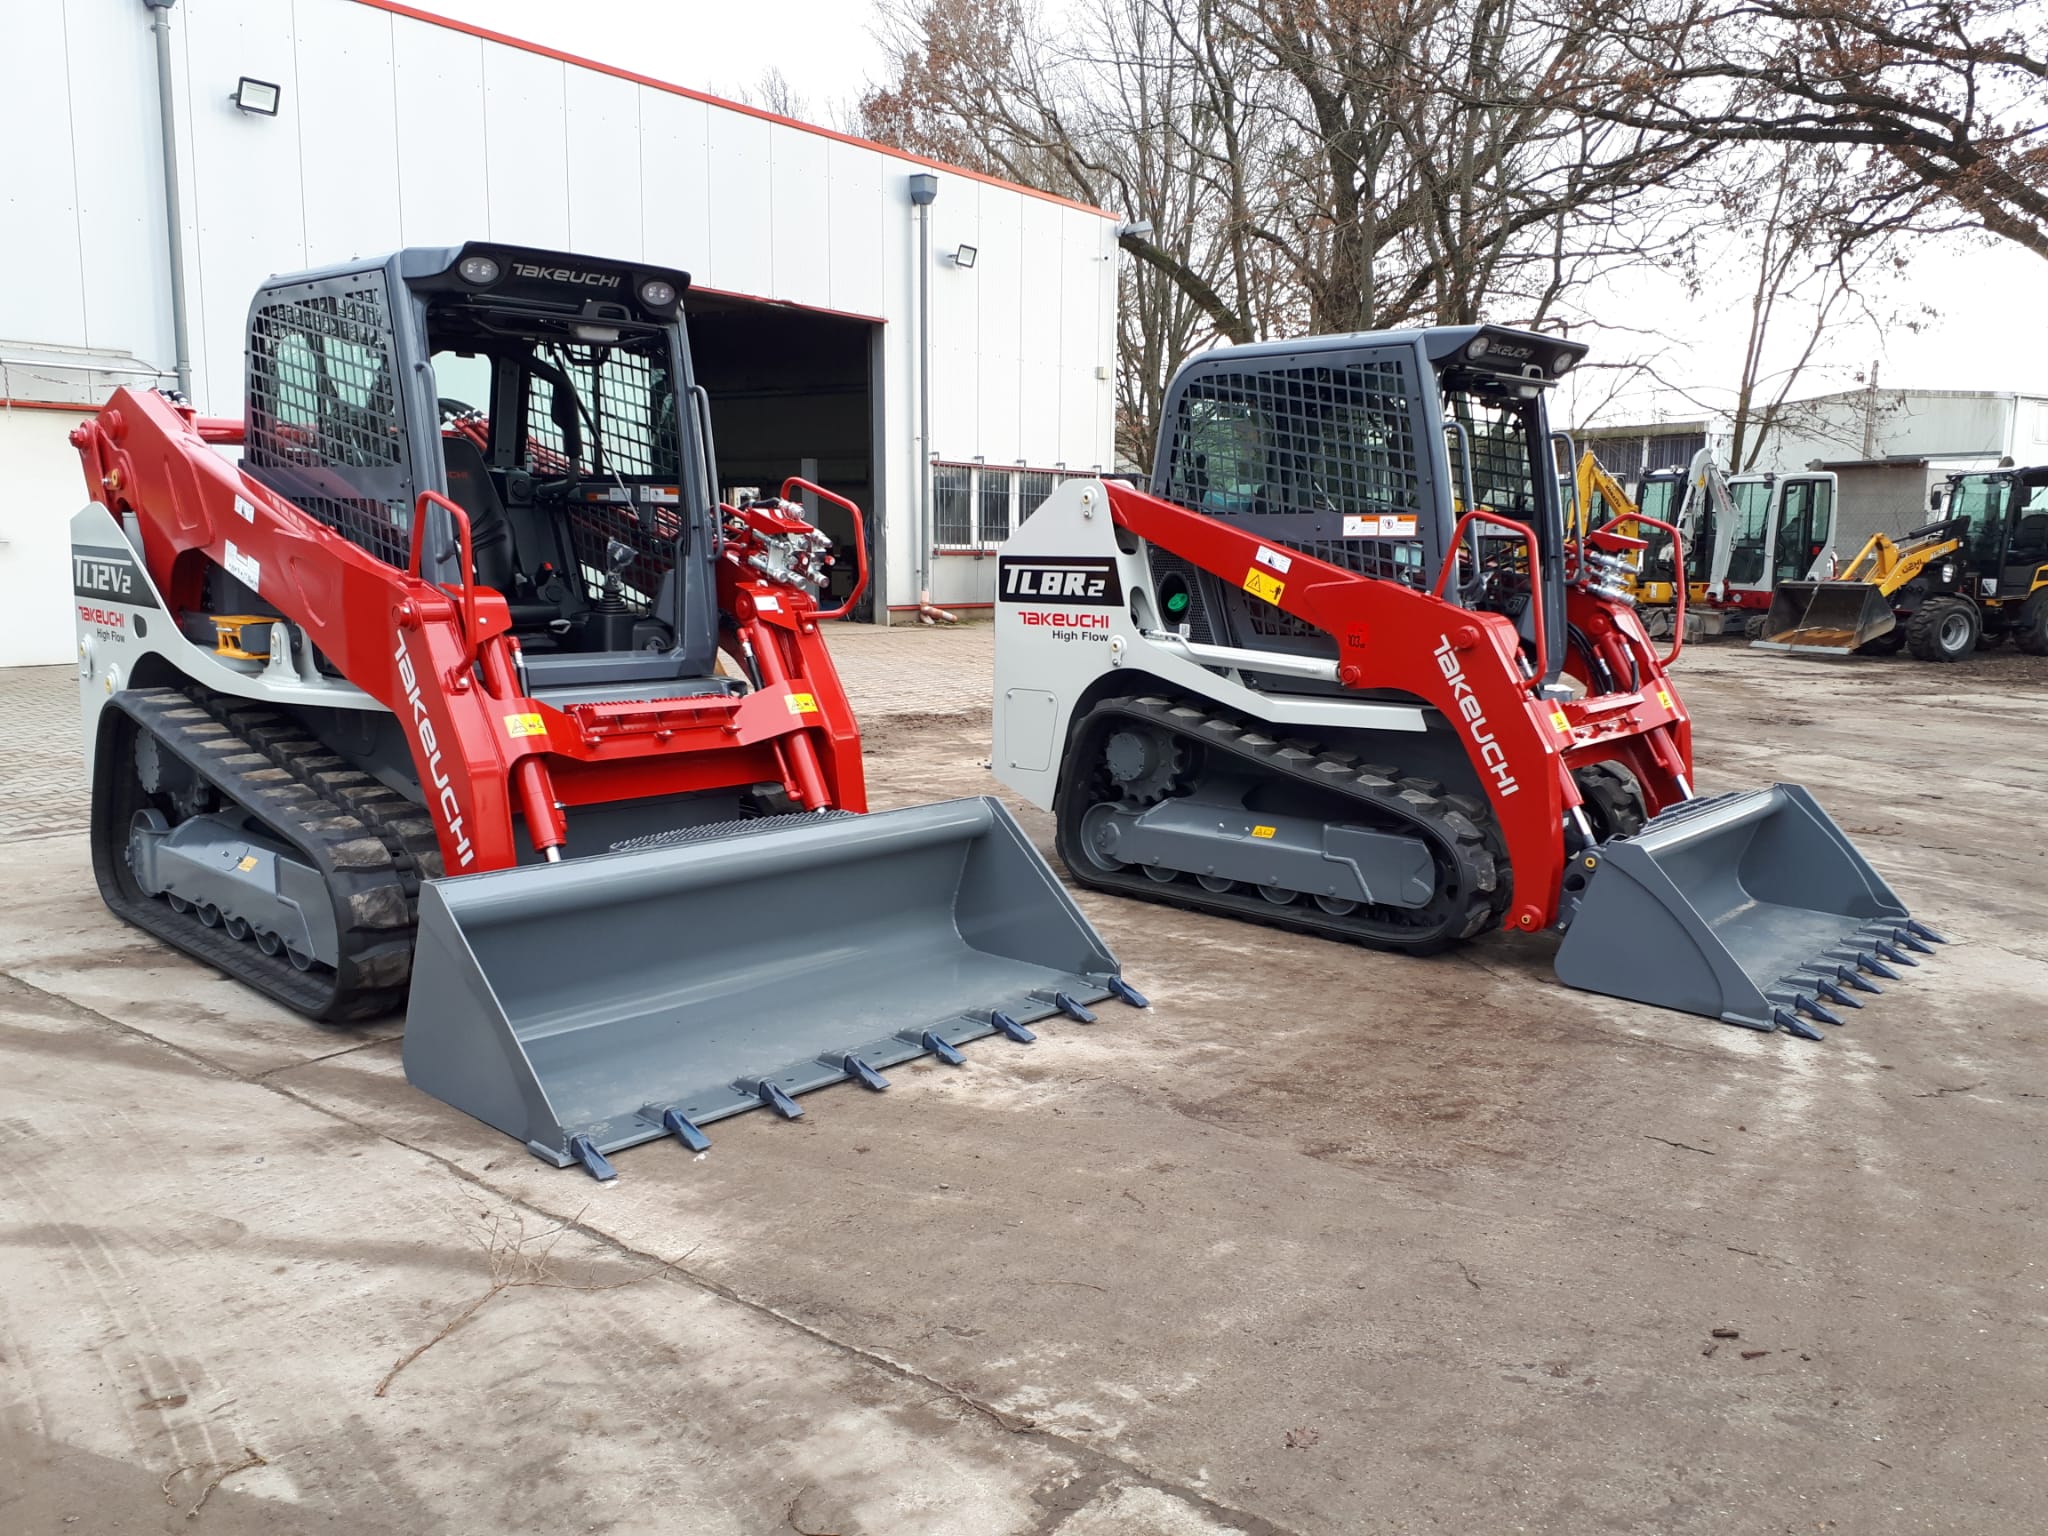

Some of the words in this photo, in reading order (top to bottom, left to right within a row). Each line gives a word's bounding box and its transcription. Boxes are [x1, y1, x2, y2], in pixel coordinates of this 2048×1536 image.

[1004, 564, 1110, 597] TL8R2
[96, 627, 110, 642] High
[111, 630, 126, 643] Flow
[1052, 630, 1078, 643] High
[1081, 631, 1109, 642] Flow
